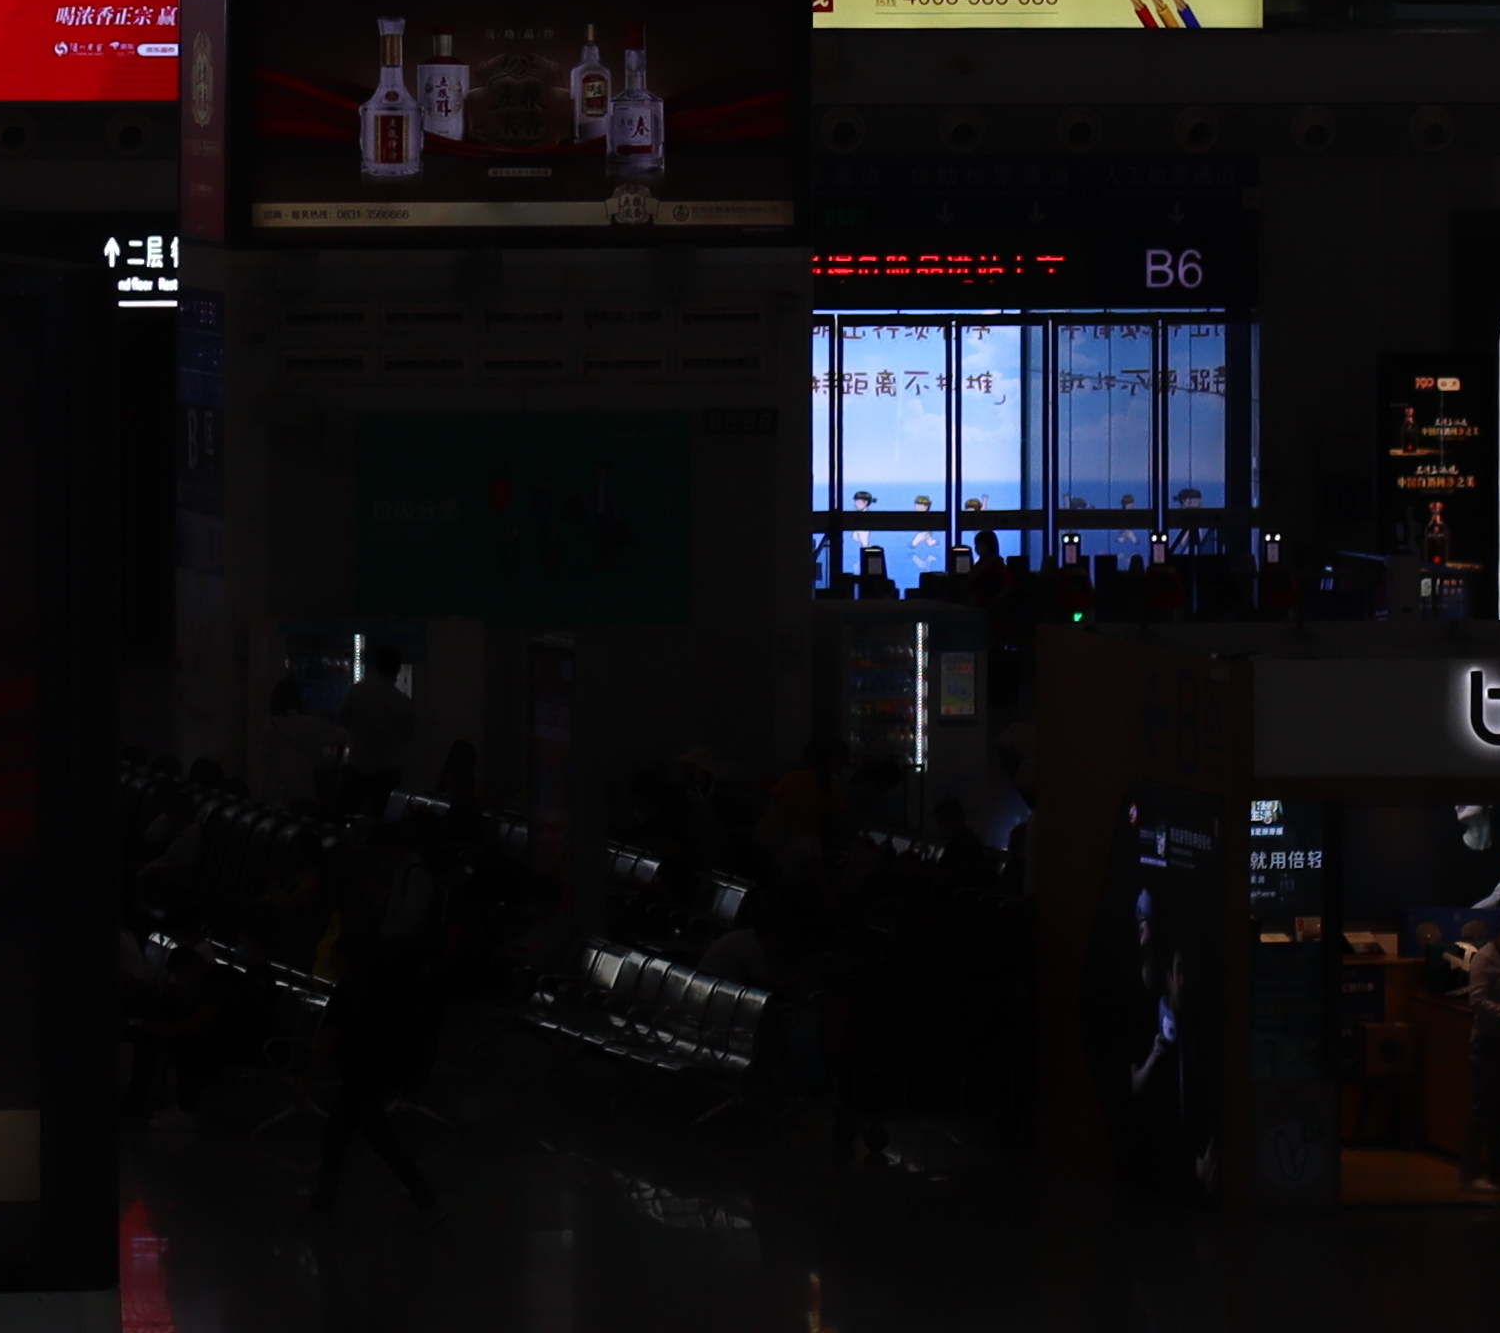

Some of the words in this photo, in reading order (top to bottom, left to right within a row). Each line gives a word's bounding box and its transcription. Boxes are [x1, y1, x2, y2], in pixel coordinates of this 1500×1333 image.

[55, 5, 154, 27] 喝浓香正宗
[156, 6, 177, 26] 赢
[126, 235, 164, 269] 二层
[1145, 249, 1203, 289] B6
[371, 499, 462, 523] 垃圾分类
